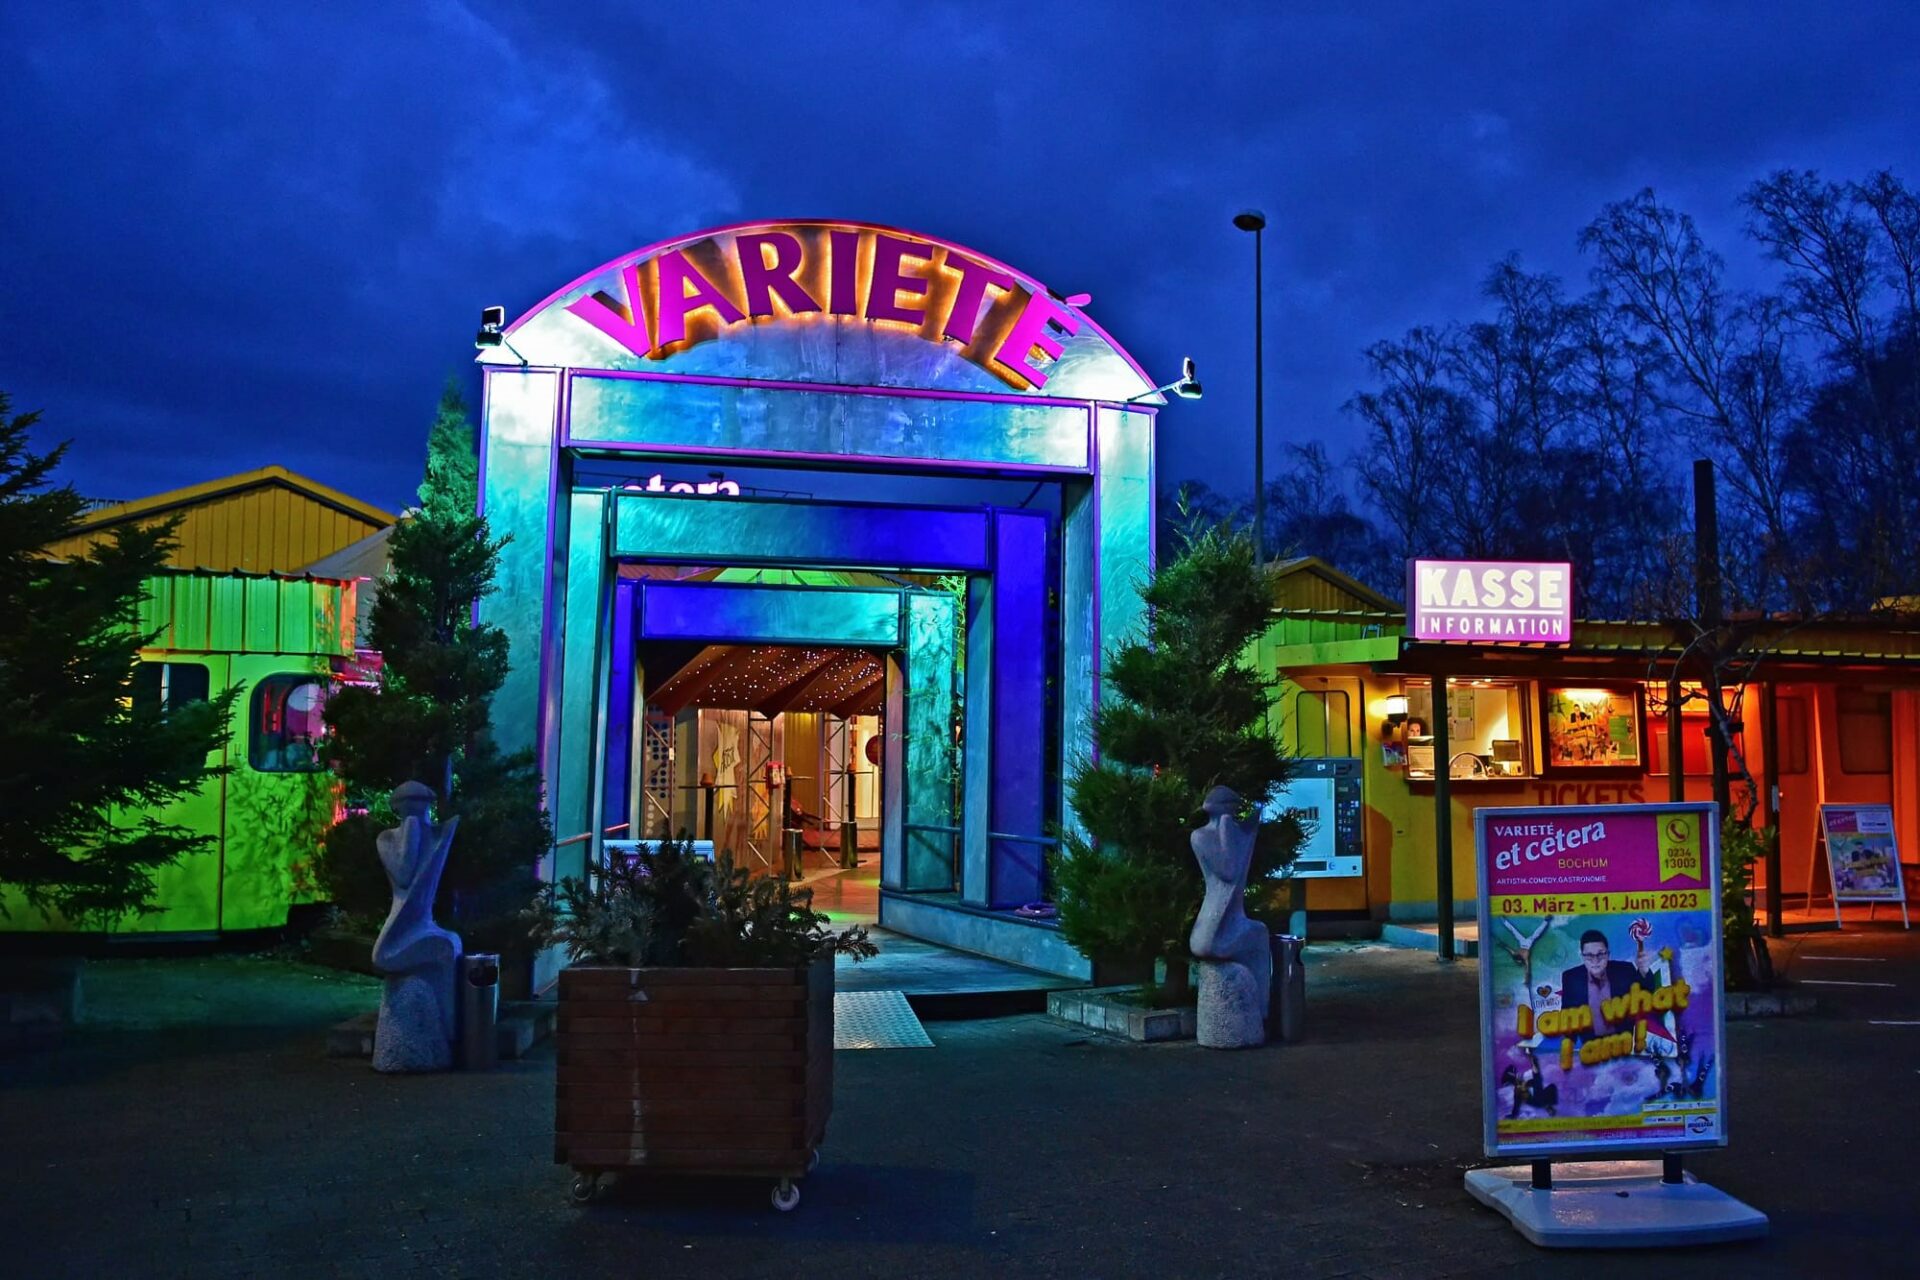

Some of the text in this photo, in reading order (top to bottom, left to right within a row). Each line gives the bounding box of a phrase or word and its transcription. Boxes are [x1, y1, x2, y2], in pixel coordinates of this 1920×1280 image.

[565, 230, 1092, 390] VARIETÉ
[1421, 568, 1562, 608] KASSE
[1421, 617, 1562, 636] INFORMATION
[1532, 783, 1646, 805] TICKETS
[1494, 822, 1554, 837] VARIETÉ
[1495, 821, 1606, 870] et cetera
[1667, 848, 1691, 858] 0234
[1558, 858, 1608, 869] BOCHUM
[1664, 858, 1696, 869] 13003
[1502, 898, 1528, 914] 03.
[1533, 896, 1575, 913] März
[1592, 896, 1616, 911] 11.
[1621, 895, 1655, 910] Juni
[1660, 893, 1698, 909] 2023
[1517, 977, 1691, 1038] I am what
[1560, 1019, 1647, 1071] I am!
